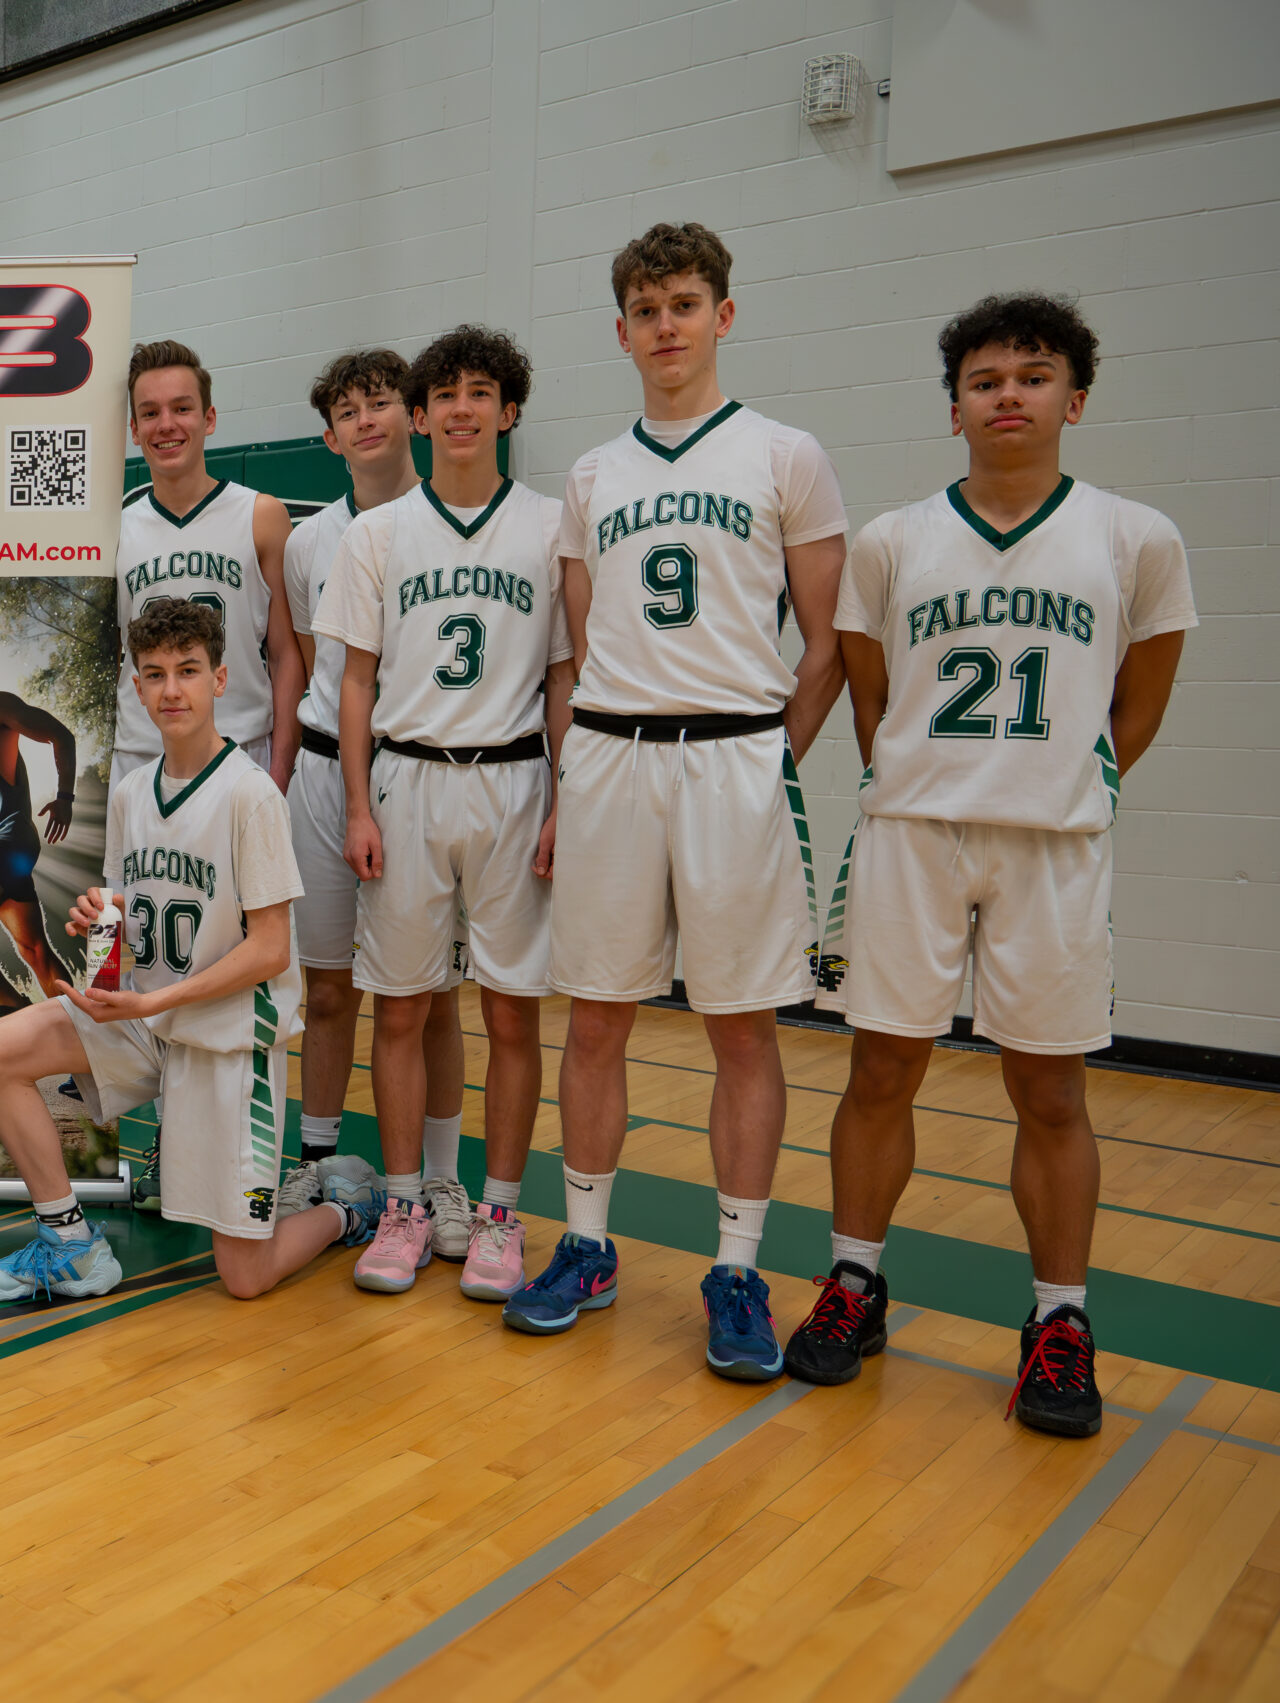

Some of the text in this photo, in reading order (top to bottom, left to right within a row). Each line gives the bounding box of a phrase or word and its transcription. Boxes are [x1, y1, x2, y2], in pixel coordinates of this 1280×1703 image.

[597, 490, 754, 558] FALCONS
[125, 550, 242, 600] FALCONS
[399, 565, 534, 619] FALCONS
[641, 542, 700, 631] 9
[433, 613, 487, 690] 3
[907, 586, 1095, 650] FALCONS
[928, 646, 1051, 741] 21
[123, 846, 217, 901] FALCONS
[129, 892, 204, 975] 30
